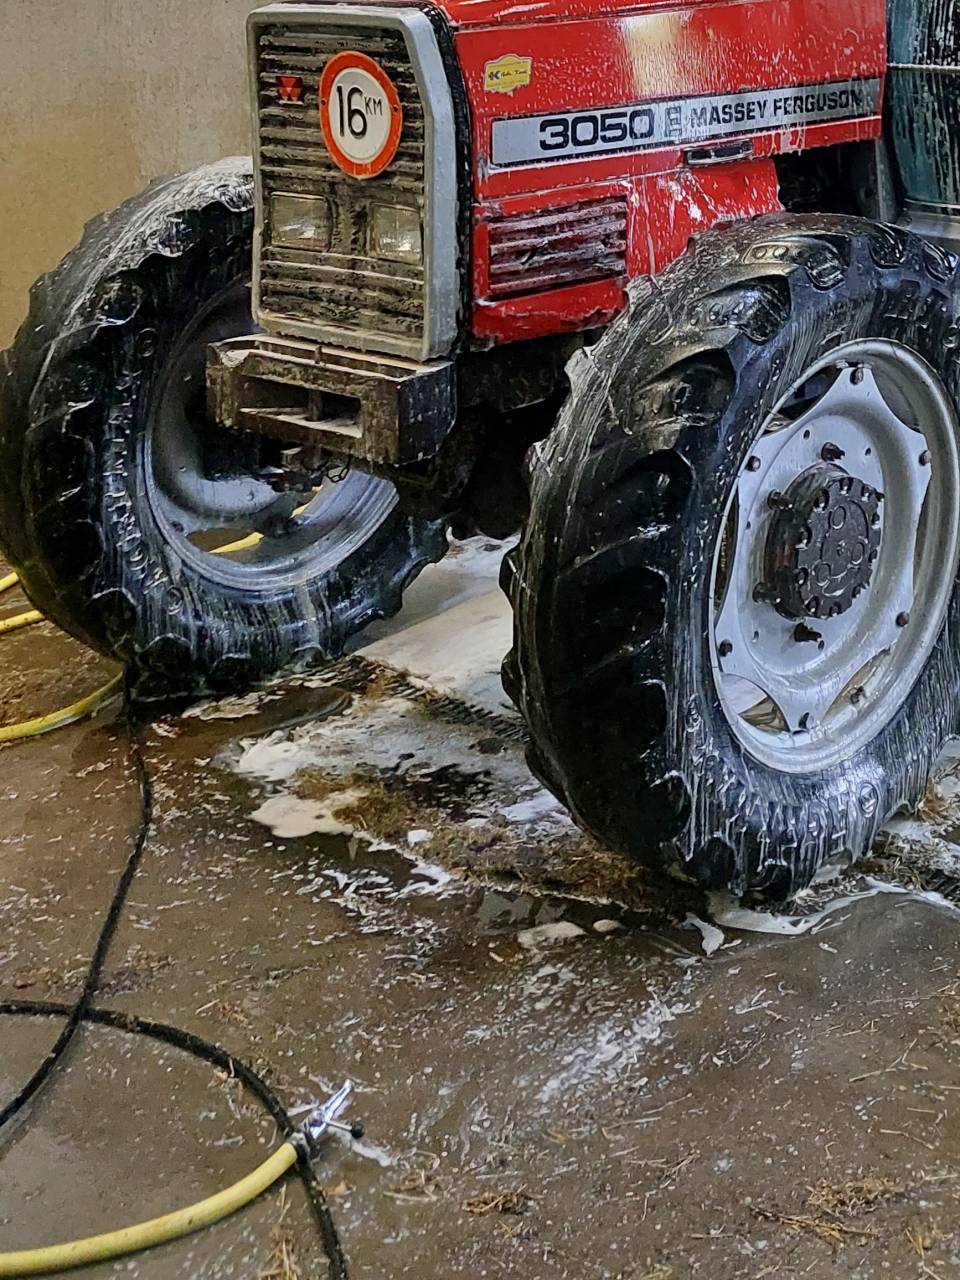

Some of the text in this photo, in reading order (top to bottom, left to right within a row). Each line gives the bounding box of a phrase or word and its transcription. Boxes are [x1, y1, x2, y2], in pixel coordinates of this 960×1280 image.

[337, 85, 383, 138] 16 KM
[539, 108, 655, 151] 3050
[690, 97, 769, 129] MASSEY
[773, 87, 863, 116] FERGUSON
